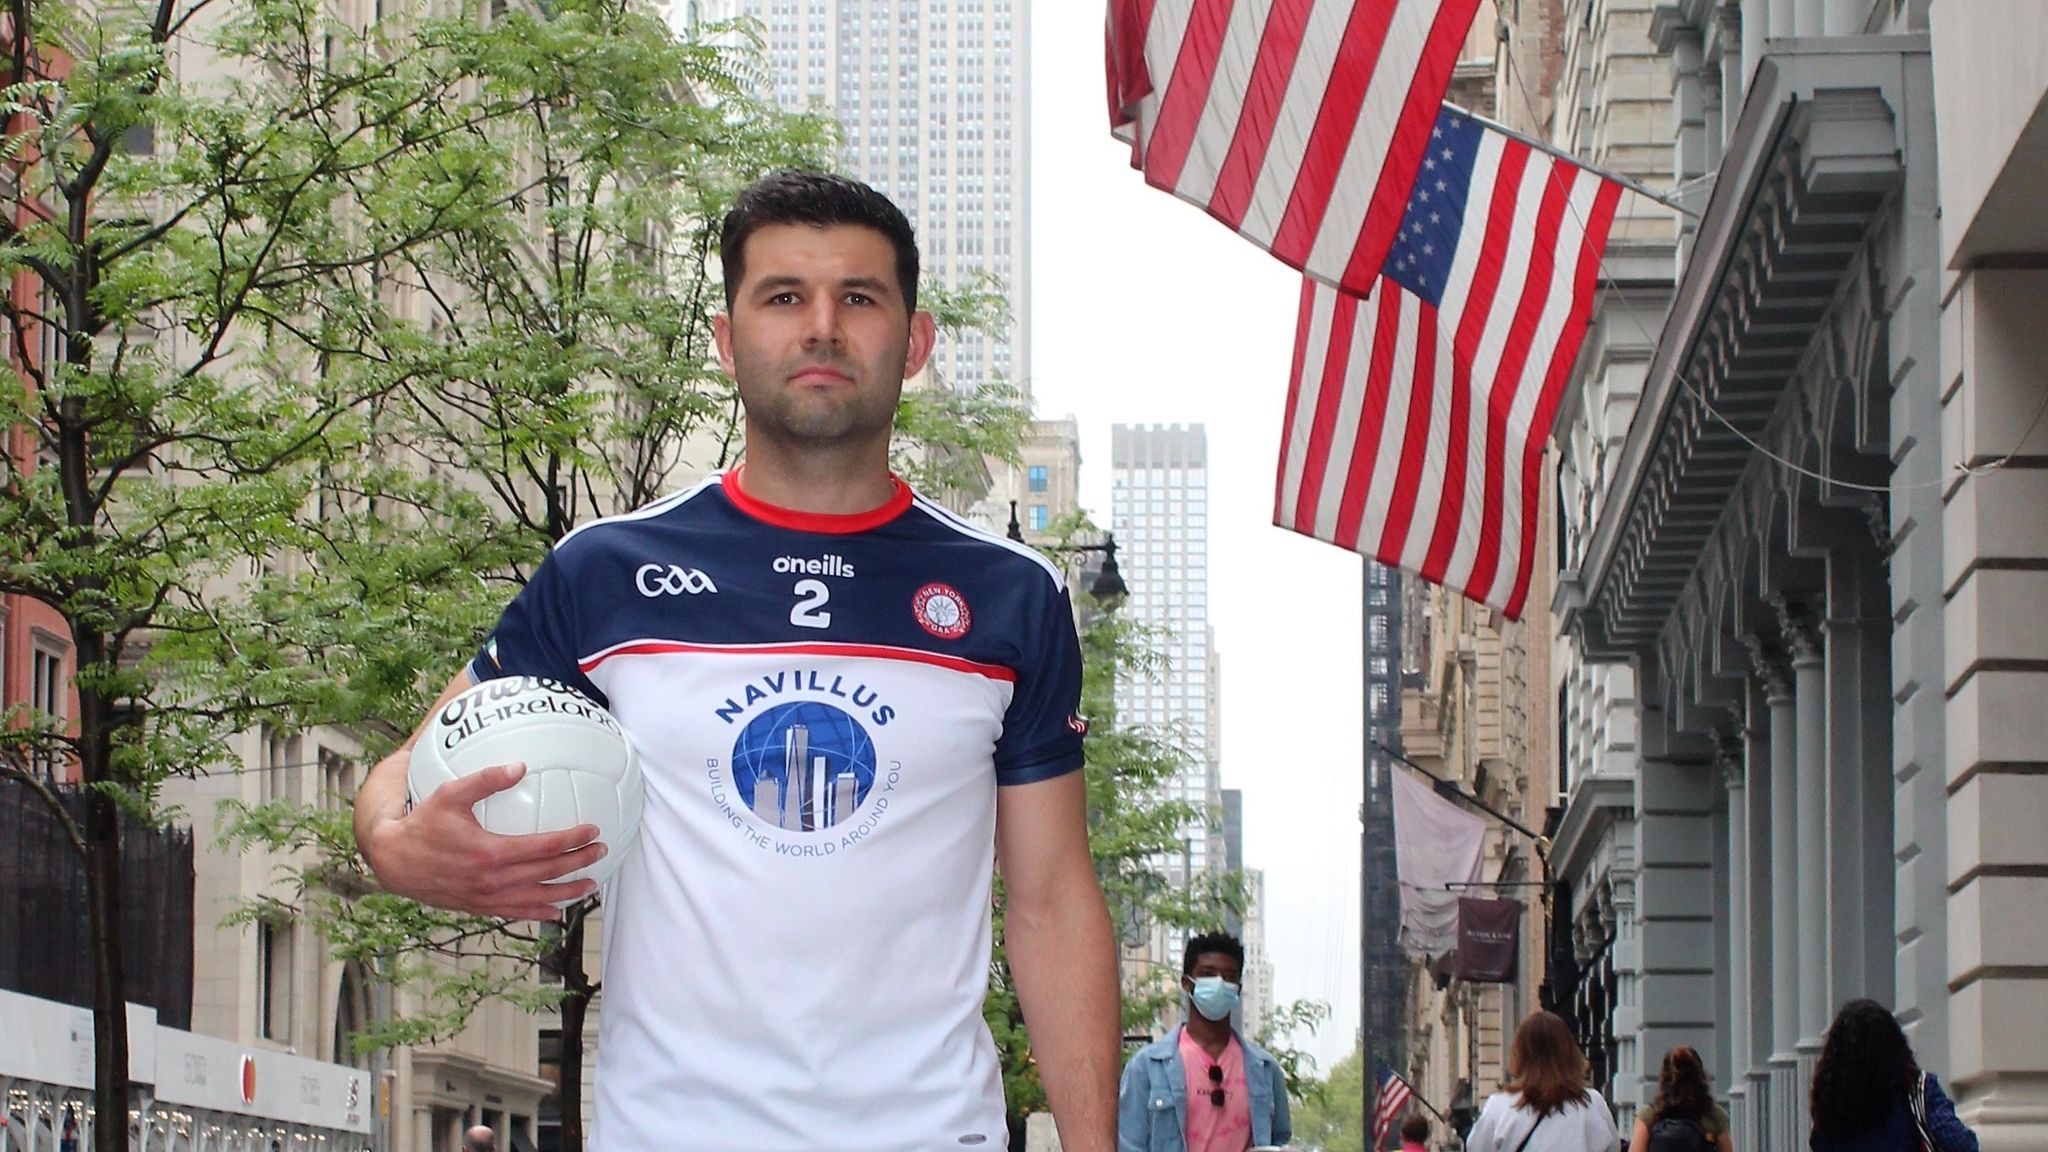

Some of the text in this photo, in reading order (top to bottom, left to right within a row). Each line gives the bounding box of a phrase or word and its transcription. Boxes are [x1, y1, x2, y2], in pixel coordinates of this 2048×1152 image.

[790, 579, 831, 629] 2
[922, 587, 941, 597] NEW
[931, 624, 950, 635] GAA
[715, 670, 896, 726] NAVILLUS
[706, 758, 902, 857] BUILDING THE WORLD AROUND YOU
